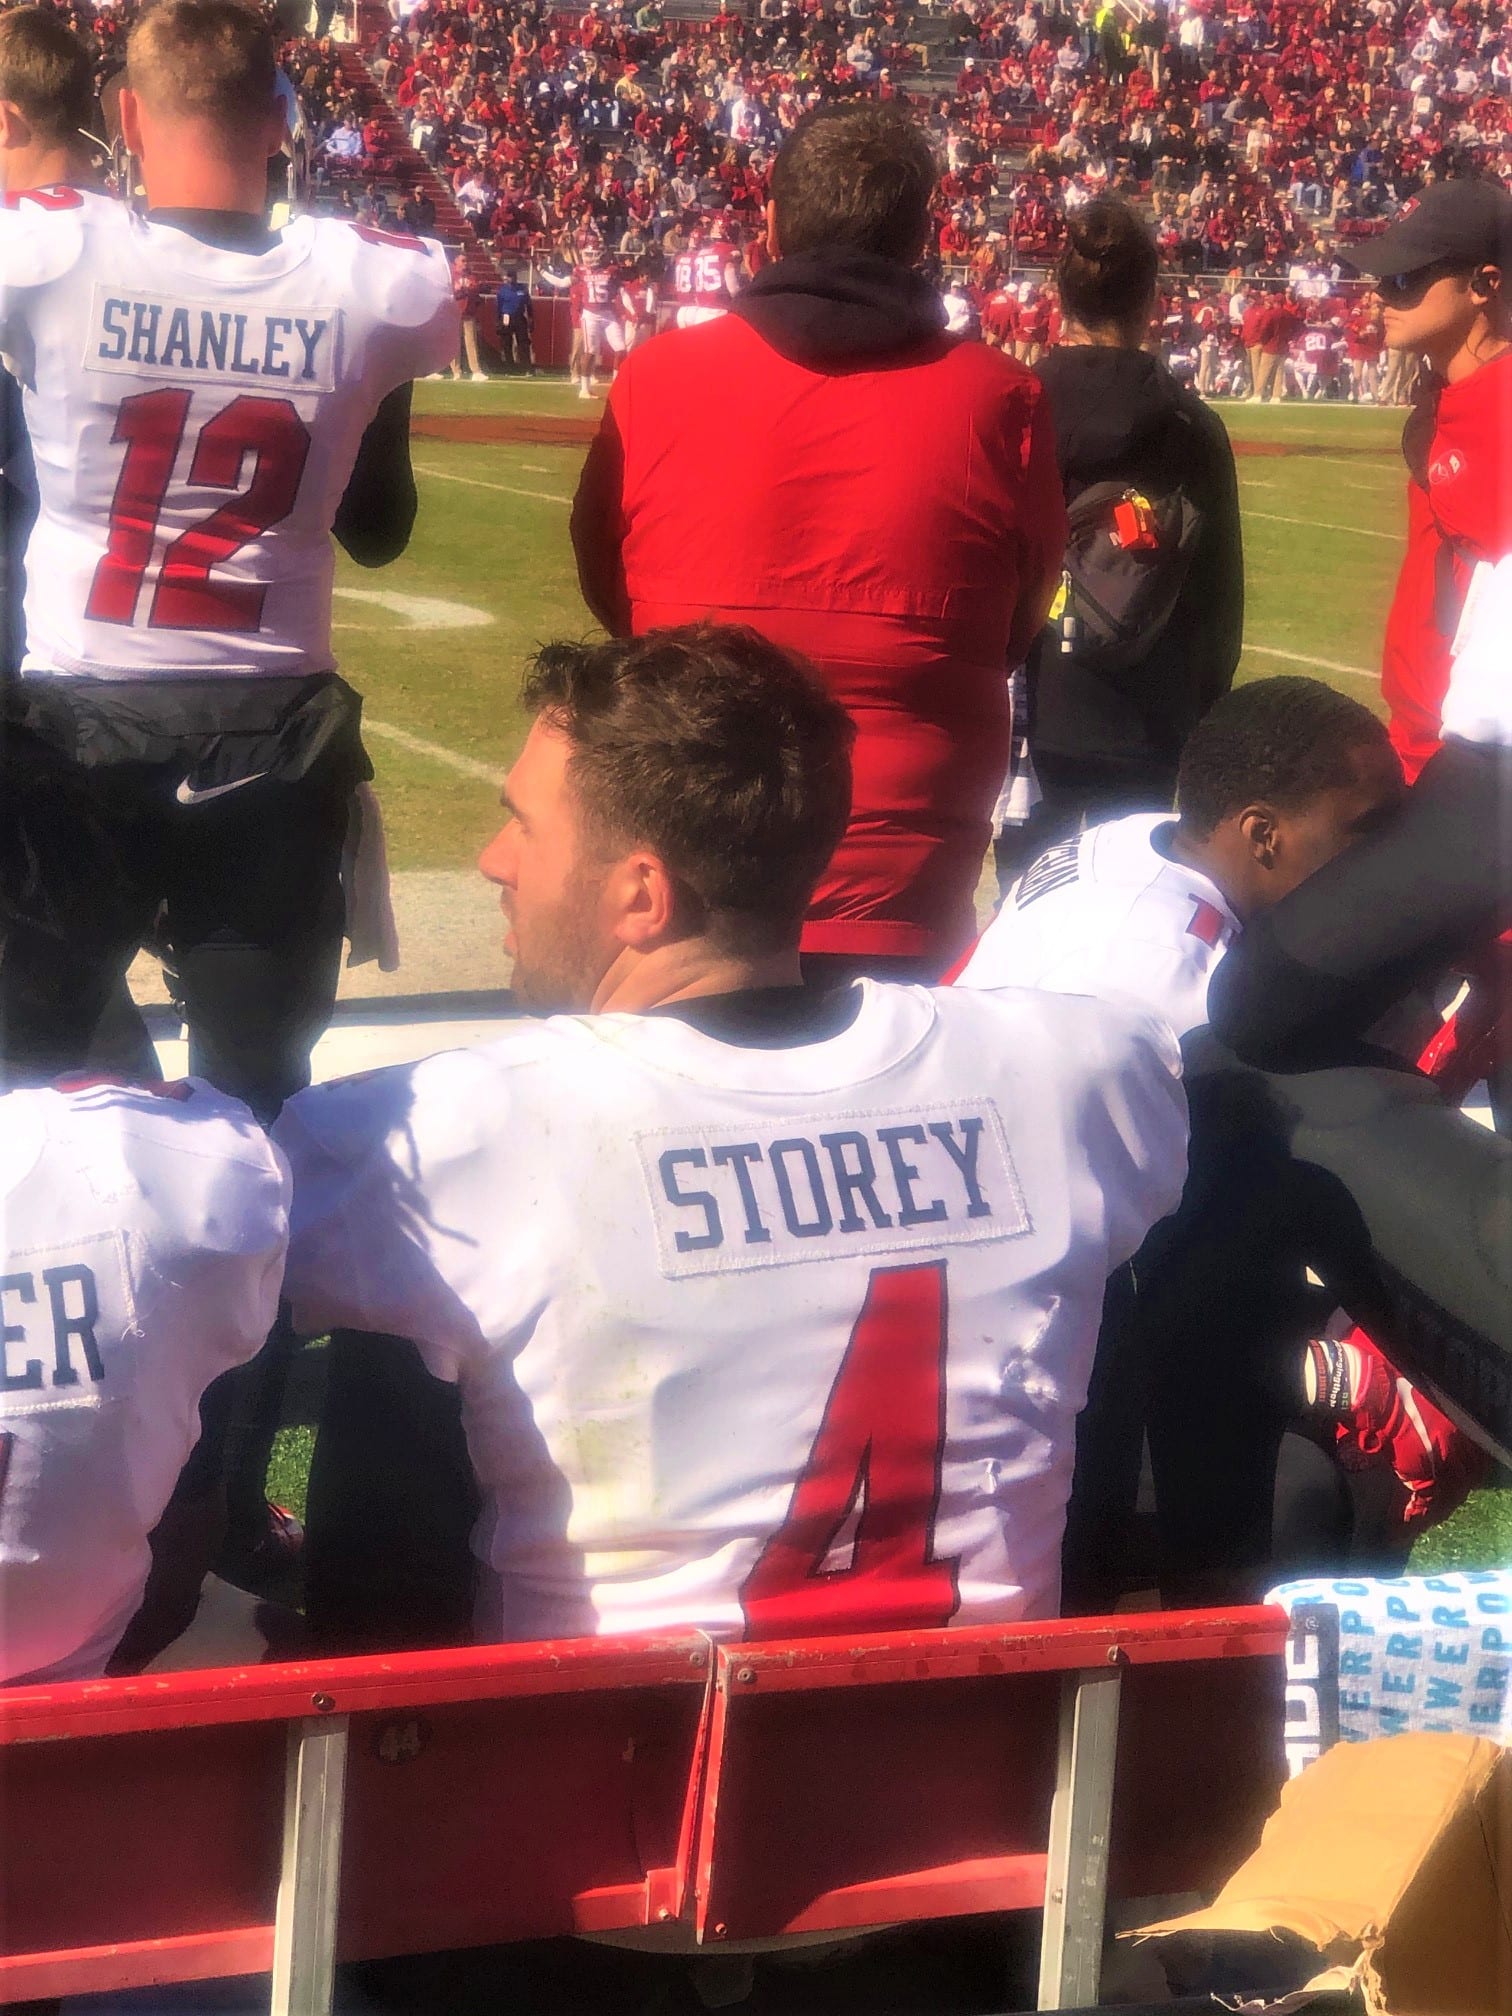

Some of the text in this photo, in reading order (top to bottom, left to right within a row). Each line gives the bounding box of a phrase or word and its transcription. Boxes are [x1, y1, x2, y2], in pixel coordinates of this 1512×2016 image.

[98, 298, 327, 379] SHANLEY
[1305, 332, 1326, 351] 20
[84, 387, 311, 633] 12
[657, 1116, 992, 1253] STOREY
[0, 1263, 104, 1391] ER
[738, 1257, 961, 1642] 4
